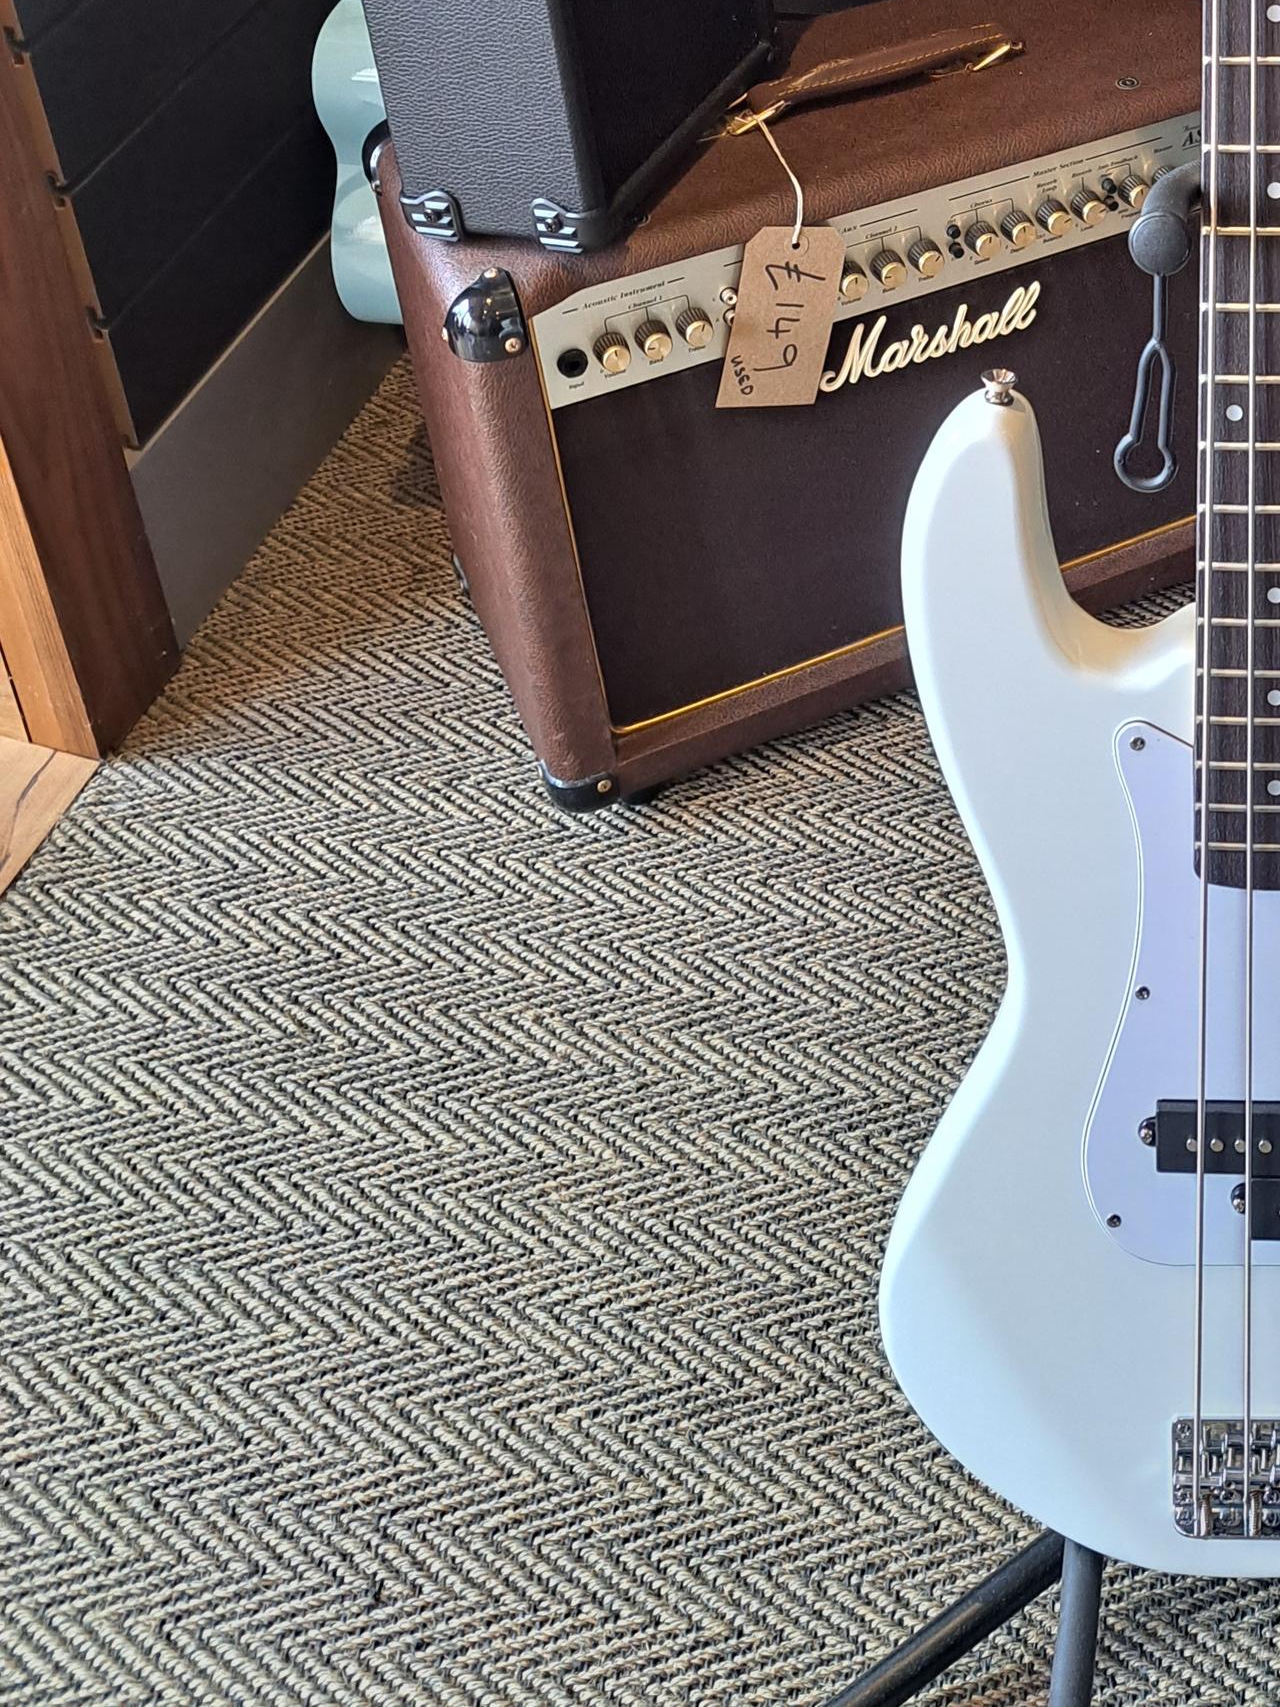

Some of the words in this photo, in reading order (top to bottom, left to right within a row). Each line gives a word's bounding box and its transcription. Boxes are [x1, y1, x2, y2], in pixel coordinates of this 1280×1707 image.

[582, 294, 618, 310] Acoustic
[619, 280, 666, 299] Instrument
[753, 260, 826, 372] £149
[730, 353, 754, 396] USED
[819, 280, 1041, 393] Marshall
